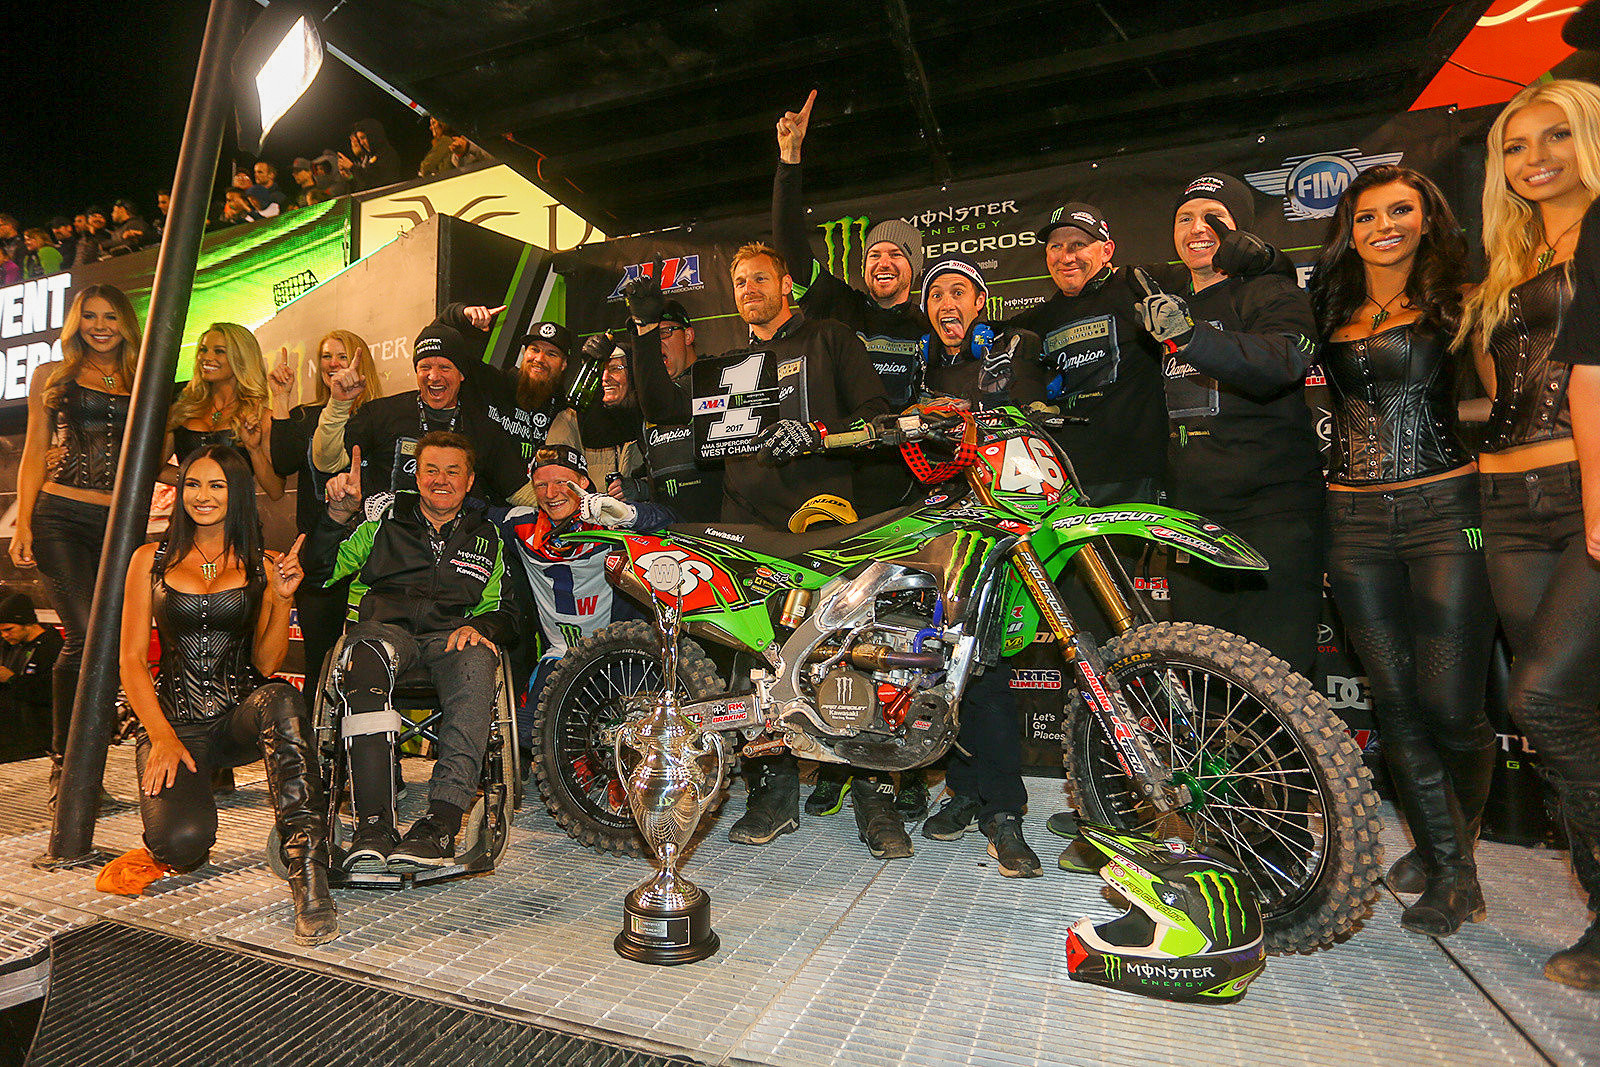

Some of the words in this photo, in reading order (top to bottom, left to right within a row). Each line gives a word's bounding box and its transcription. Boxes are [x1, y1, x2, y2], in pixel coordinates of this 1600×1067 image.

[1298, 173, 1349, 199] FIM
[0, 272, 71, 339] ENT
[698, 398, 725, 411] AMA
[649, 428, 692, 446] Champion
[725, 424, 744, 433] 2017
[701, 447, 725, 458] WEST
[1000, 436, 1065, 494] 46
[1052, 514, 1085, 532] PRO
[1086, 511, 1167, 525] CIRCUIT
[705, 527, 747, 544] Kawasaki
[456, 566, 488, 584] Kawasaki
[543, 564, 577, 616] 1
[576, 595, 599, 616] W
[1020, 551, 1043, 580] PRO
[1037, 579, 1074, 632] CIRCUIT
[1009, 680, 1062, 690] LIMITED
[1079, 661, 1114, 712] BRAKING
[728, 702, 744, 711] RK
[713, 712, 747, 723] BRAKING
[1033, 713, 1056, 723] Let's
[1032, 722, 1047, 731] Go
[1033, 730, 1066, 741] Places
[1126, 963, 1216, 980] MONSTER
[1141, 979, 1205, 987] ENERGY
